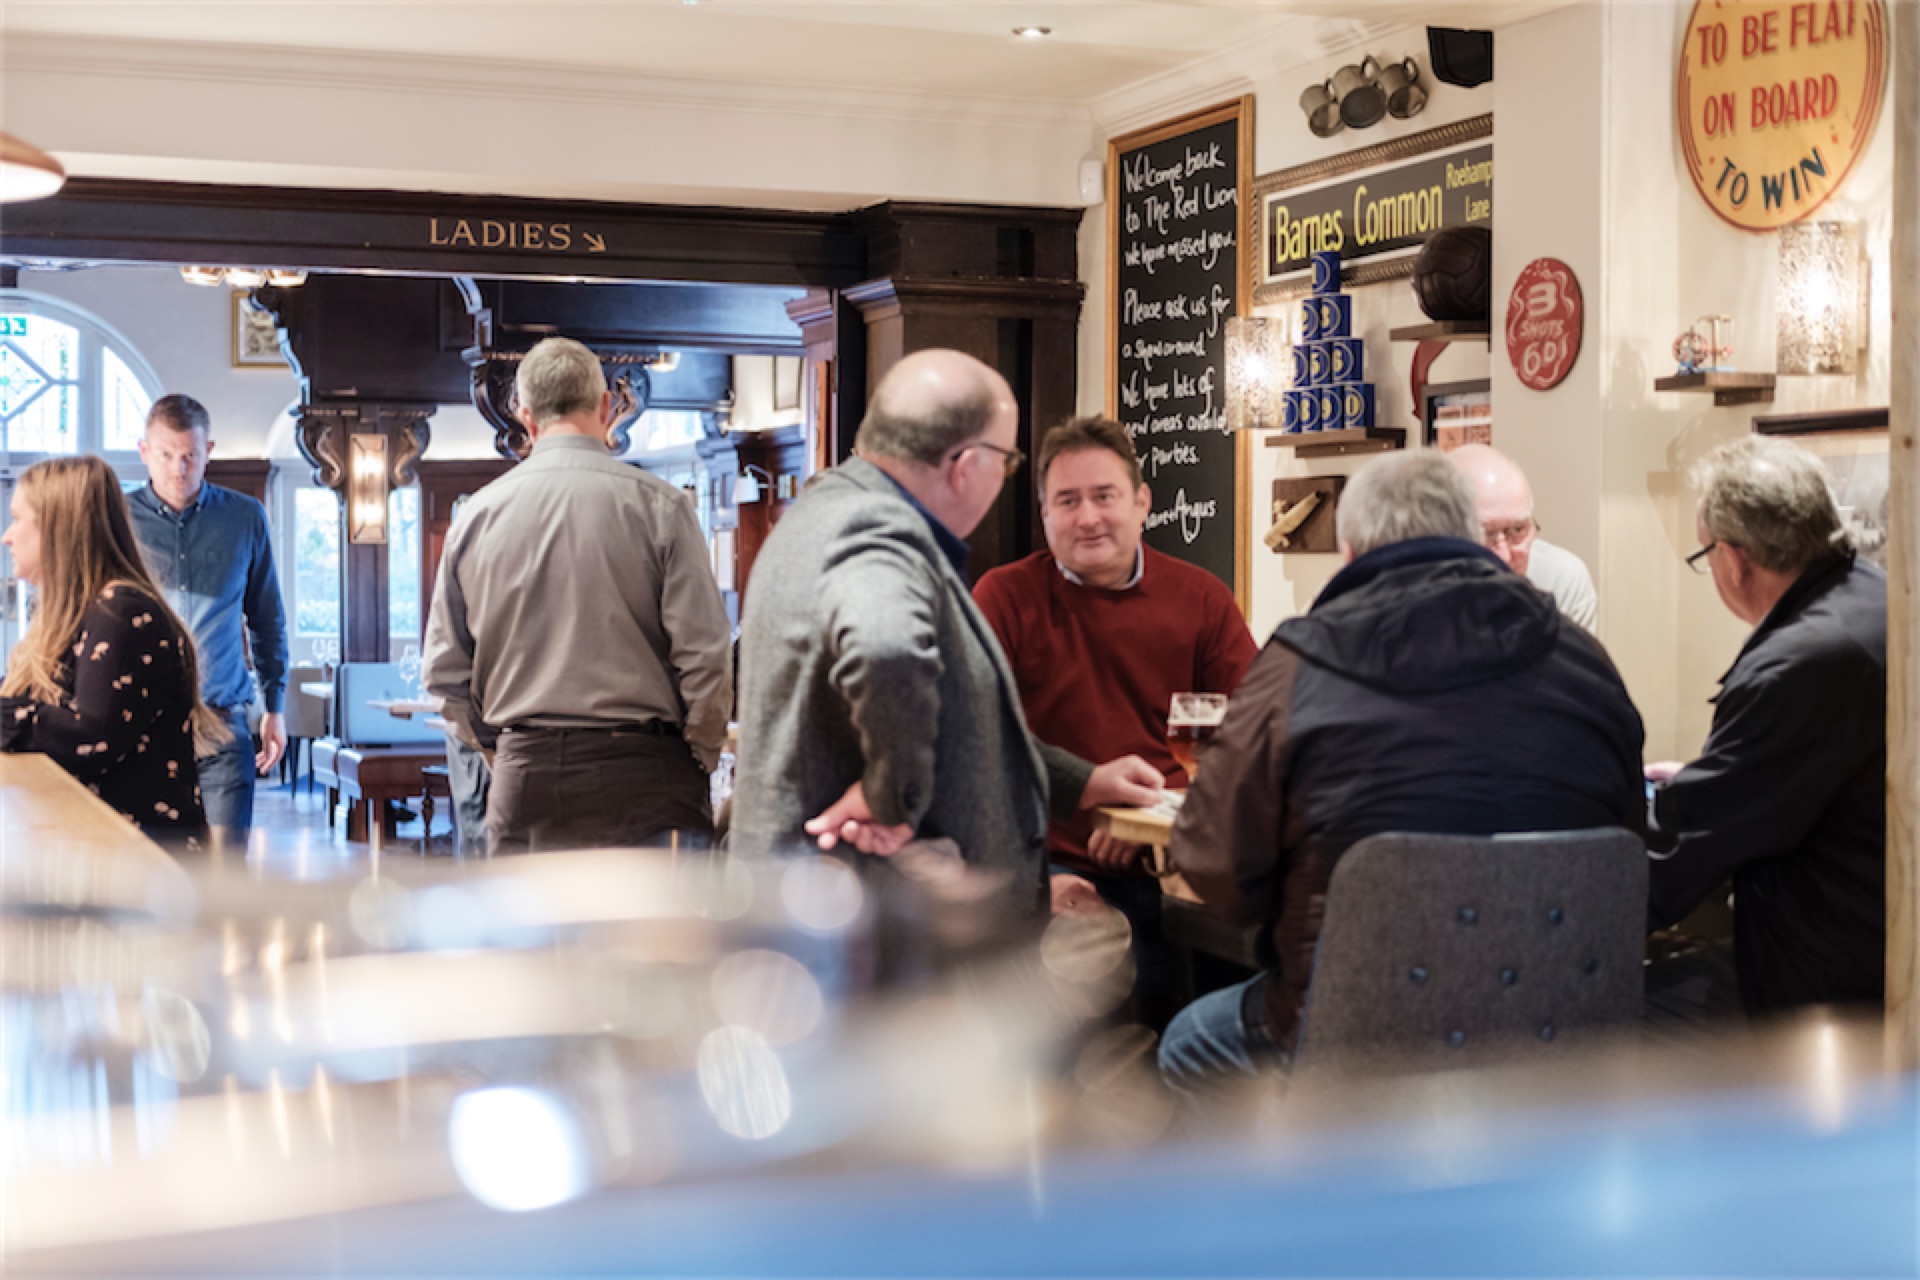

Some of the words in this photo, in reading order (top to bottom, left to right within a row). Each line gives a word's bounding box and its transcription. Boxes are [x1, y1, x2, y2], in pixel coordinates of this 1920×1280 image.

[1697, 22, 1727, 66] TO
[1742, 11, 1778, 58] BE
[1703, 92, 1735, 136] ON
[1751, 73, 1838, 129] BOARD
[1124, 153, 1183, 193] Welcome
[1185, 142, 1226, 177] back
[1716, 156, 1748, 207] TO
[1761, 147, 1828, 211] WIN
[429, 217, 571, 250] LADIES
[1144, 196, 1170, 236] The
[1173, 185, 1199, 220] Red
[1276, 206, 1344, 264] Barnes
[1354, 184, 1443, 246] Common
[1465, 195, 1490, 223] Lane
[1141, 242, 1165, 274] have
[1167, 230, 1206, 262] missed
[1124, 287, 1162, 325] Please
[1165, 294, 1189, 320] ask
[1190, 295, 1207, 316] us
[1207, 283, 1230, 338] for
[1528, 282, 1557, 317] 3
[1520, 319, 1564, 338] SHOTS
[1122, 370, 1140, 408] We
[1143, 377, 1168, 412] have
[1173, 368, 1196, 398] lots
[1198, 366, 1215, 420] of
